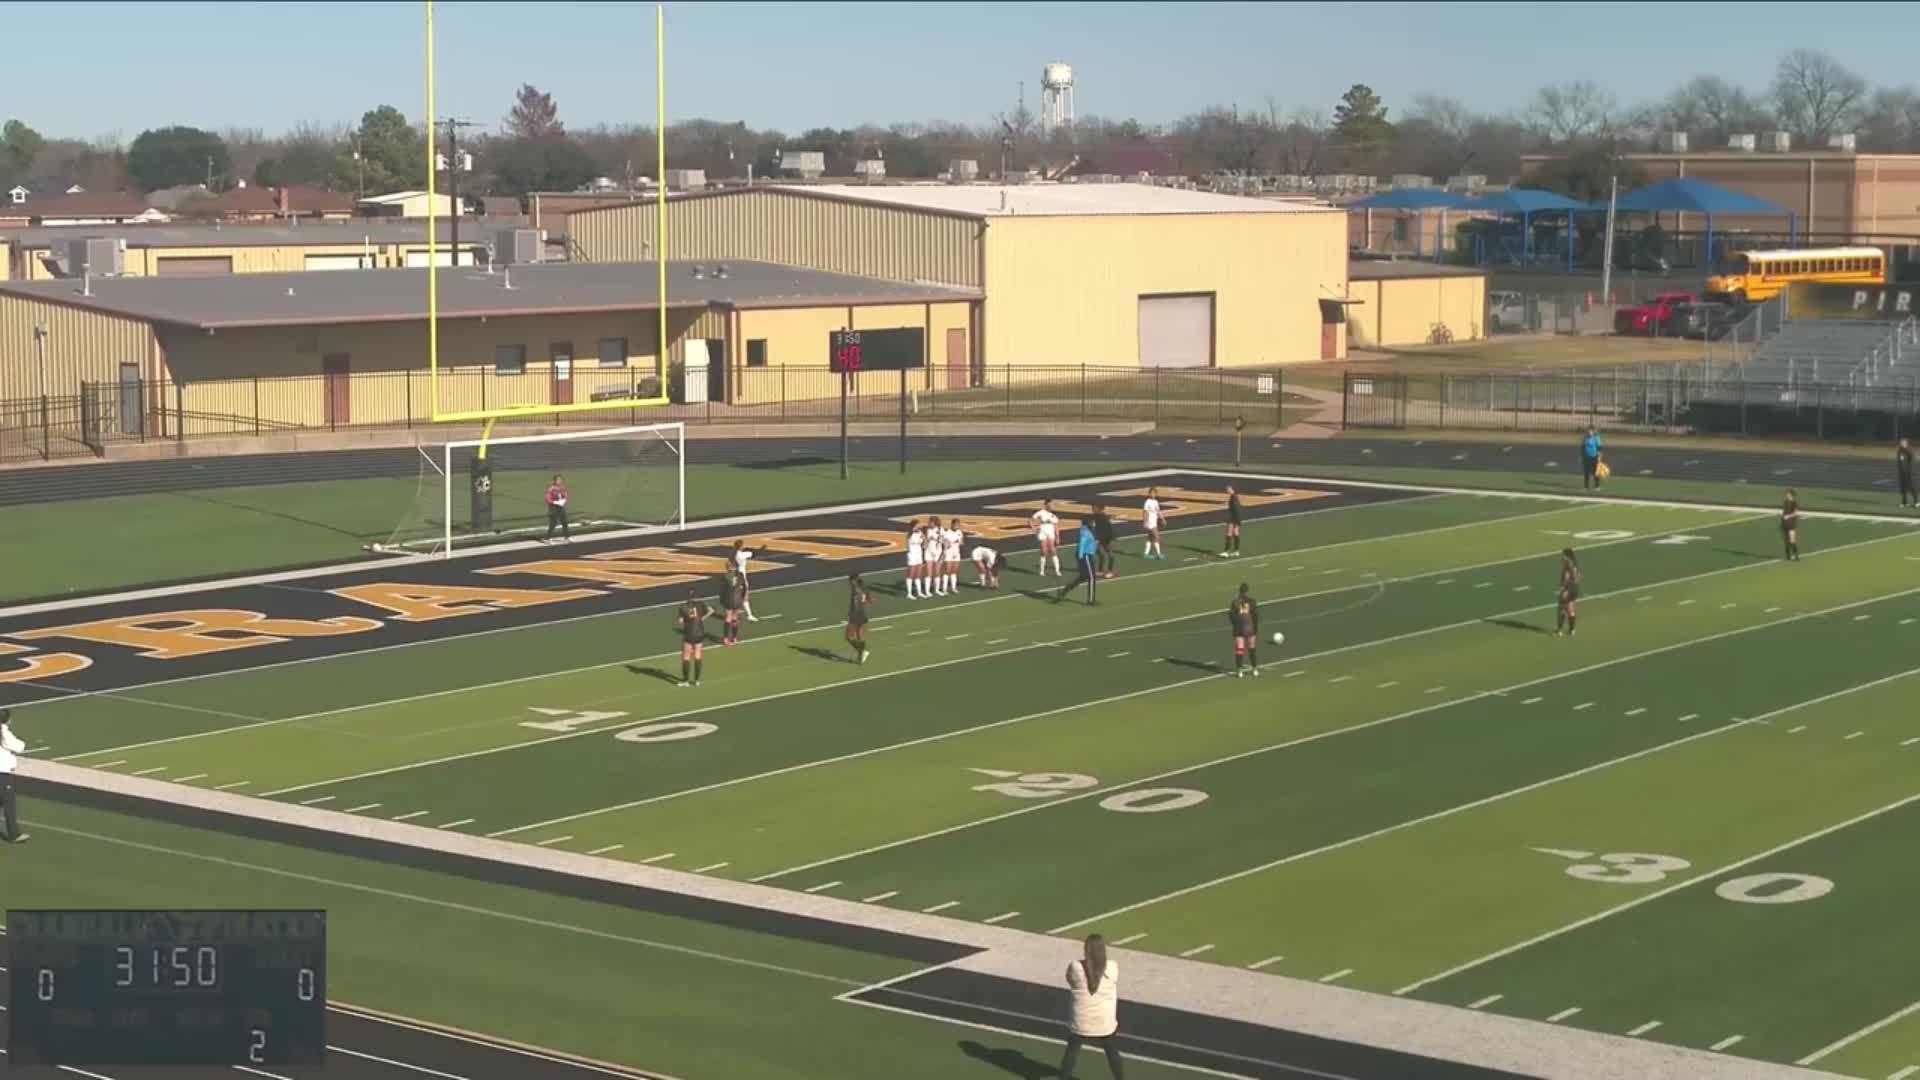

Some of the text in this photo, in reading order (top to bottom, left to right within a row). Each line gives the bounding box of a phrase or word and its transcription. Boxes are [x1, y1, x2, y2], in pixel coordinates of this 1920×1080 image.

[1853, 290, 1912, 311] PIR
[838, 345, 862, 369] 40
[517, 709, 720, 743] 10
[970, 770, 1210, 814] 20
[1563, 851, 1836, 904] 30
